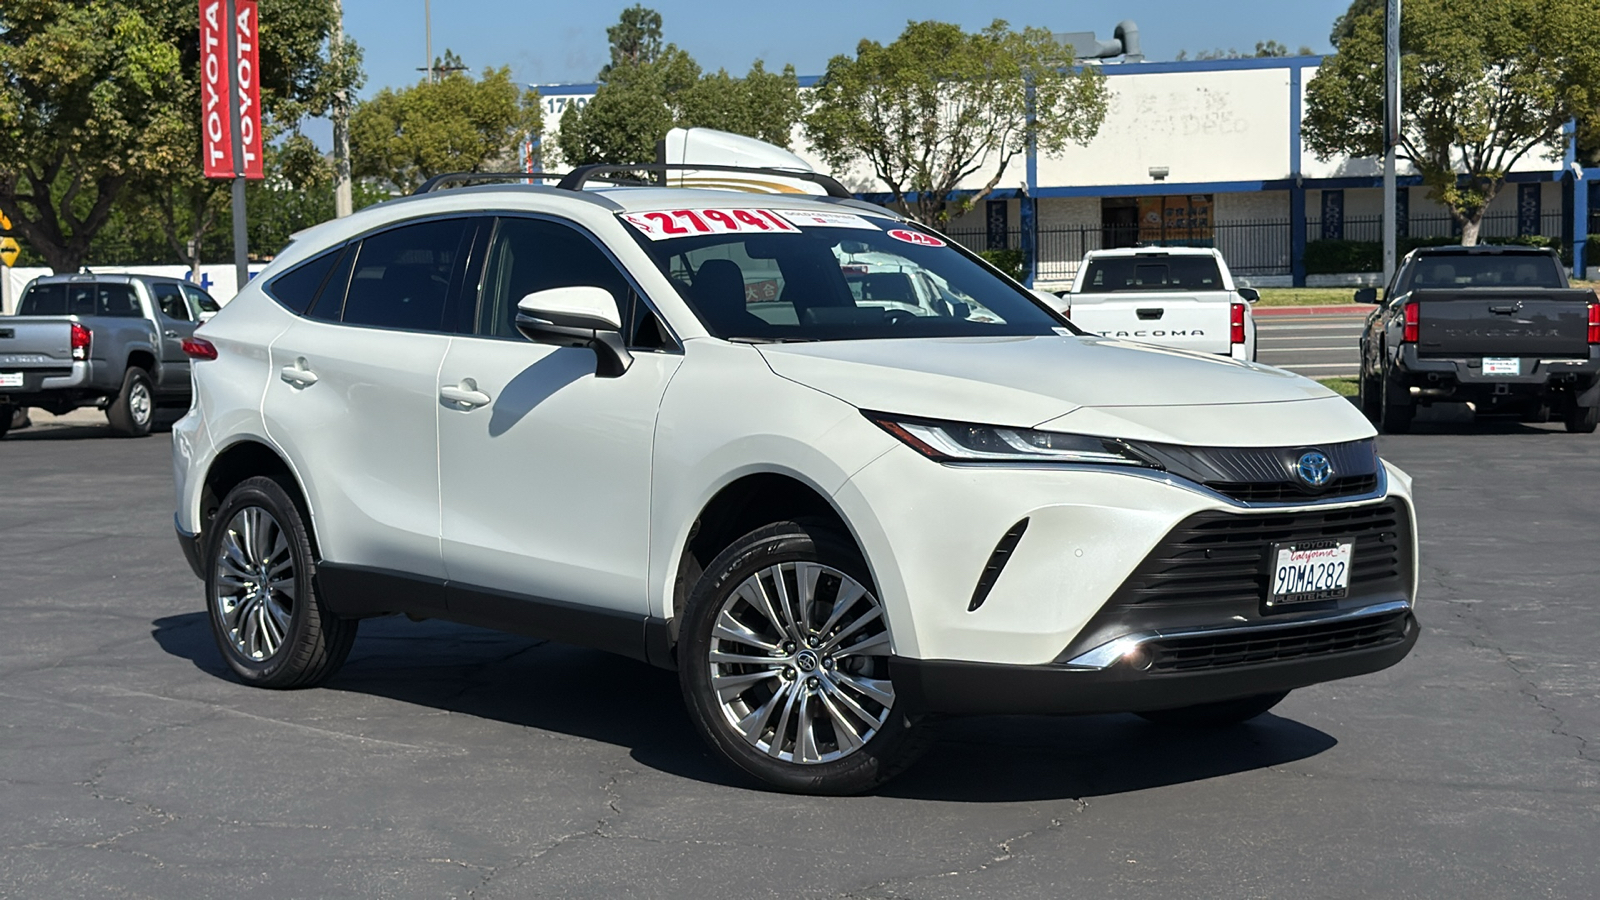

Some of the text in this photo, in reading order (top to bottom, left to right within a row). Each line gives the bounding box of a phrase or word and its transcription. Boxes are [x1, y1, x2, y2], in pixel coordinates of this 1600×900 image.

[205, 1, 224, 168] TOYOTA
[237, 7, 256, 169] TOYOTA
[626, 208, 795, 235] $27941
[902, 230, 931, 245] 22
[1097, 329, 1205, 337] TACOMA
[1297, 539, 1337, 550] TOYOTA
[1290, 549, 1338, 563] California
[1276, 561, 1345, 594] 9DMA282
